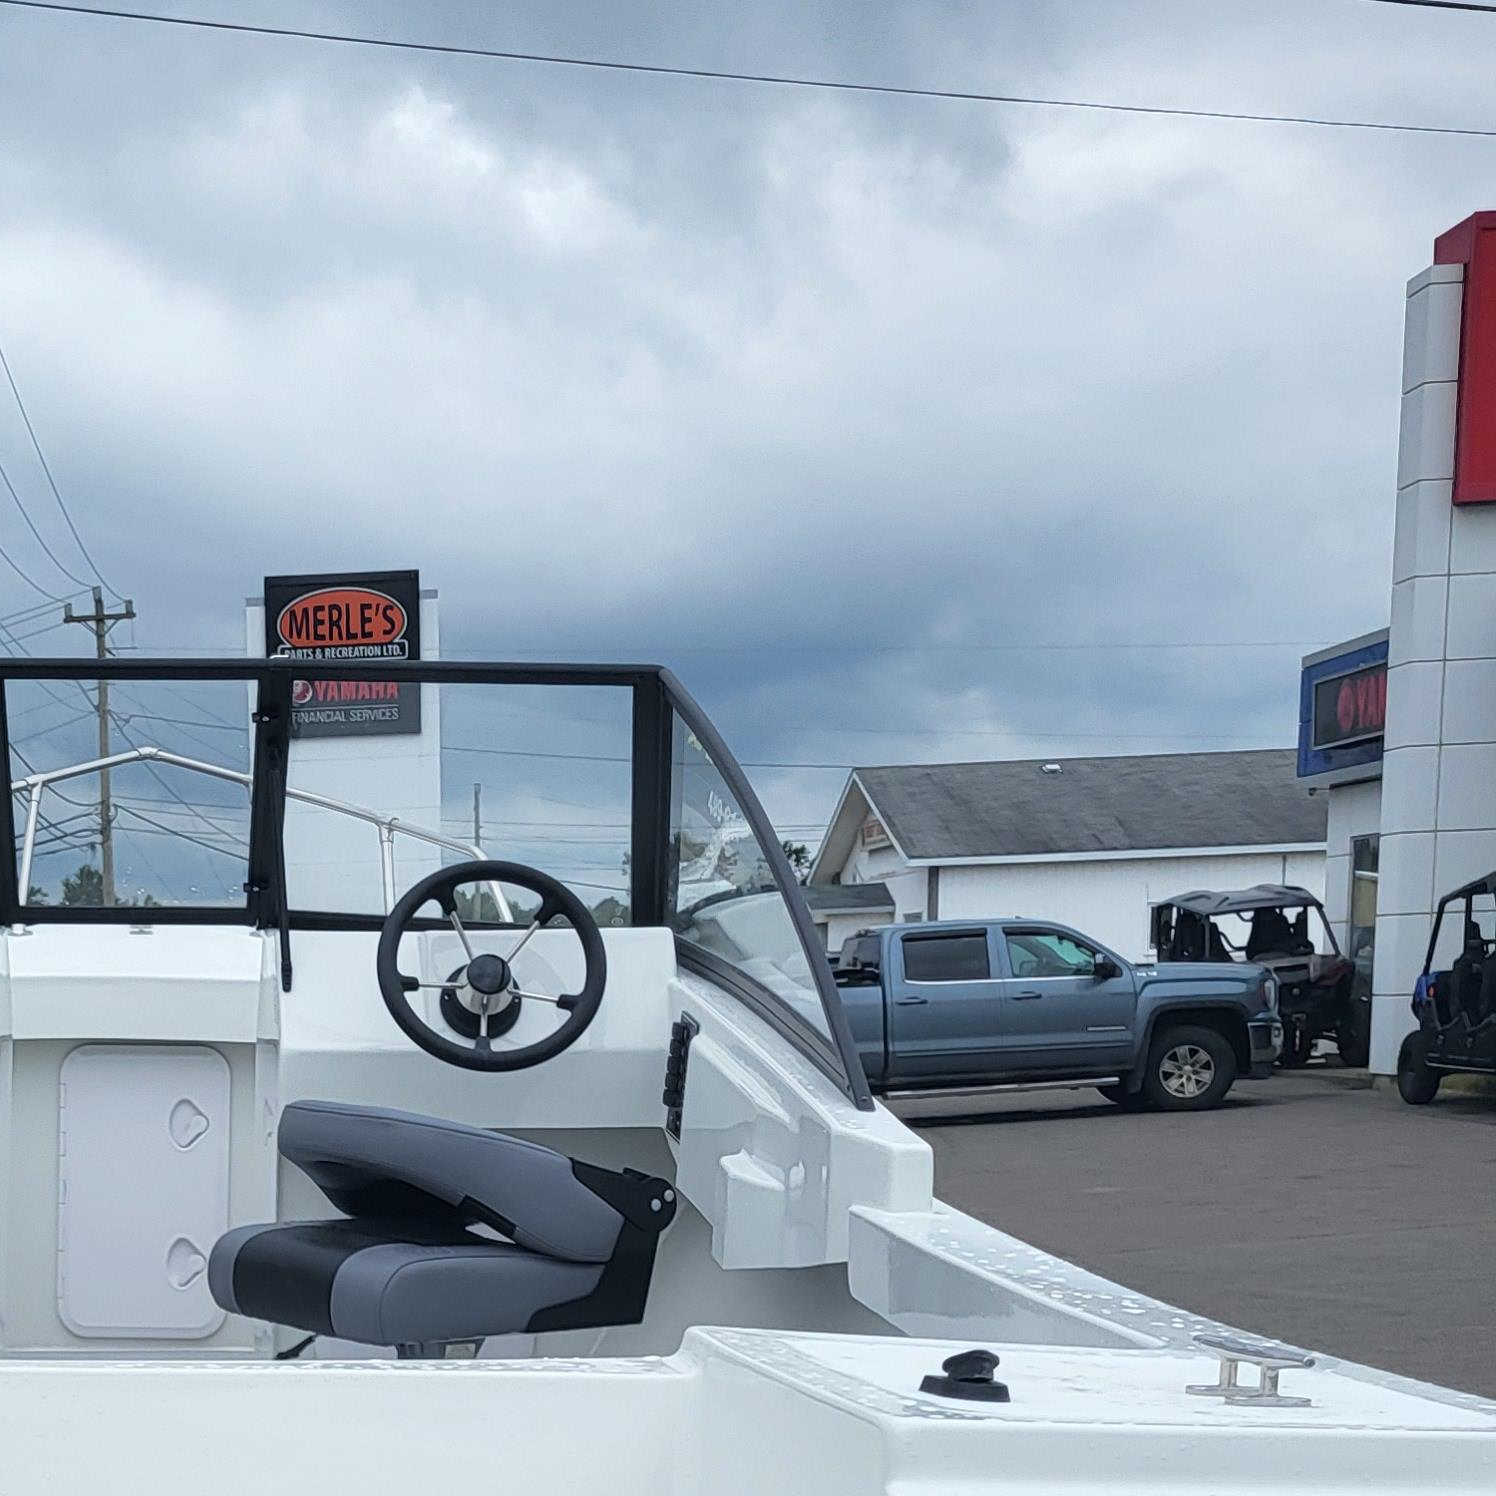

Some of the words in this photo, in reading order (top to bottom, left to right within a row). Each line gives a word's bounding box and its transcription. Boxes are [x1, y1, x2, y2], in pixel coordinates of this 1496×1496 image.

[288, 603, 396, 641] MERLE'S
[285, 647, 314, 660] PARTS
[315, 648, 322, 659] &
[324, 645, 382, 659] RECREATION
[383, 644, 403, 656] LTD.
[314, 680, 399, 701] YAMAHA
[291, 710, 346, 723] FINANCIAL
[349, 708, 399, 722] SERVICES
